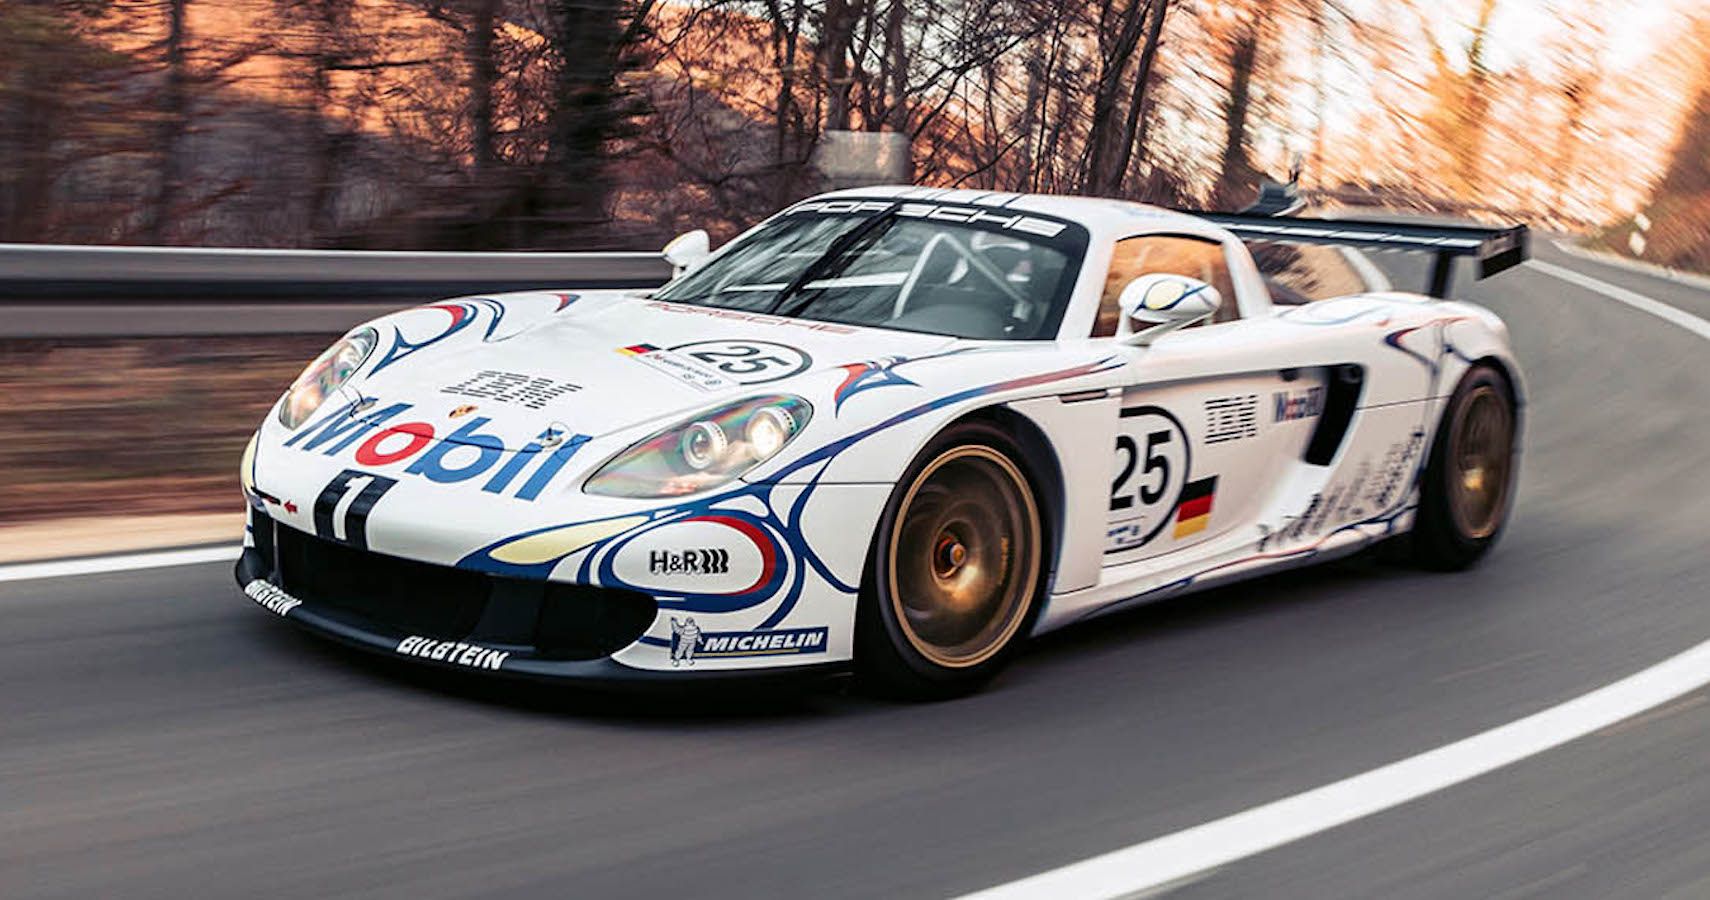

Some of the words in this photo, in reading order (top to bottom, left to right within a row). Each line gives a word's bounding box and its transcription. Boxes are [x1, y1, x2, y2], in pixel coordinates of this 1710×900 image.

[785, 201, 1067, 237] PORSCHE
[648, 302, 857, 334] PORSCHE
[689, 346, 791, 374] 25
[440, 370, 583, 409] IBM
[1203, 394, 1259, 444] IBM
[283, 398, 593, 501] Mobil
[1110, 430, 1171, 511] 25
[650, 551, 698, 573] H&R
[396, 635, 509, 670] BILSTEIN
[703, 631, 823, 652] MICHELIN
